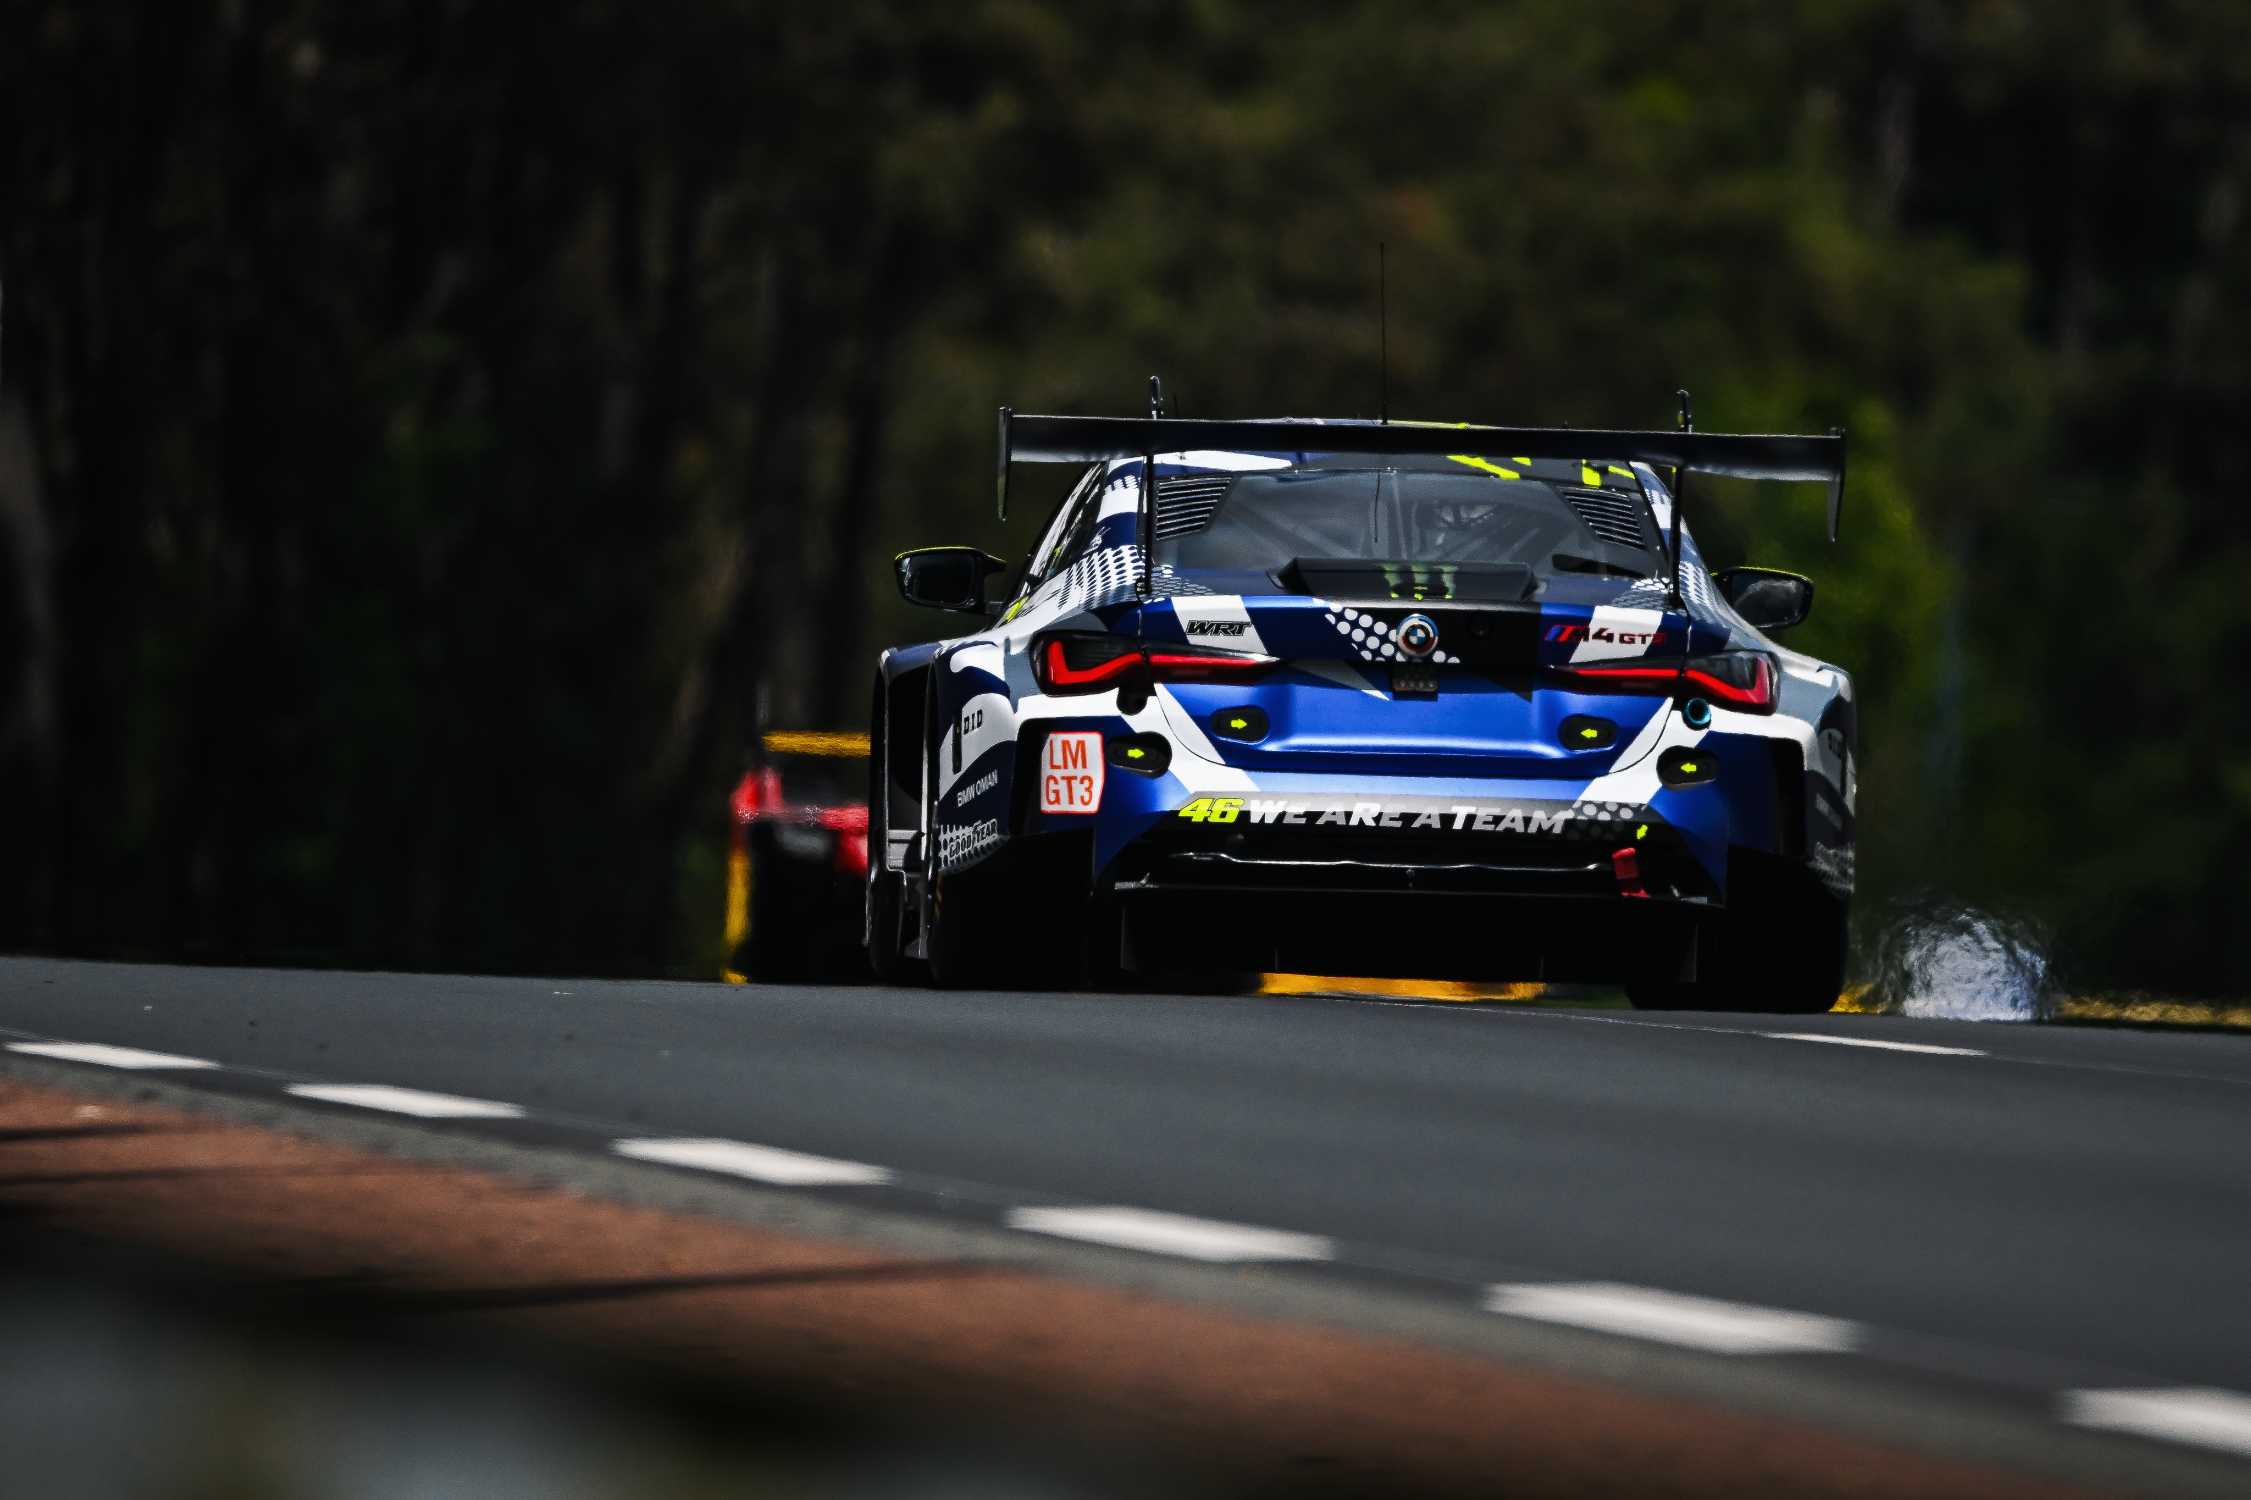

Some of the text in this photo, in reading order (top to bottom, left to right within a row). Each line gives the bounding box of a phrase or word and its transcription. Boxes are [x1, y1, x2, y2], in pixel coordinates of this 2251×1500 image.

[1186, 620, 1251, 636] WRT
[1049, 739, 1087, 769] LM
[957, 769, 998, 807] BMW OMAN
[1045, 775, 1093, 806] GT3
[1178, 798, 1574, 834] 46 WE ARE A TEAM
[949, 821, 998, 857] GOODYEAR
